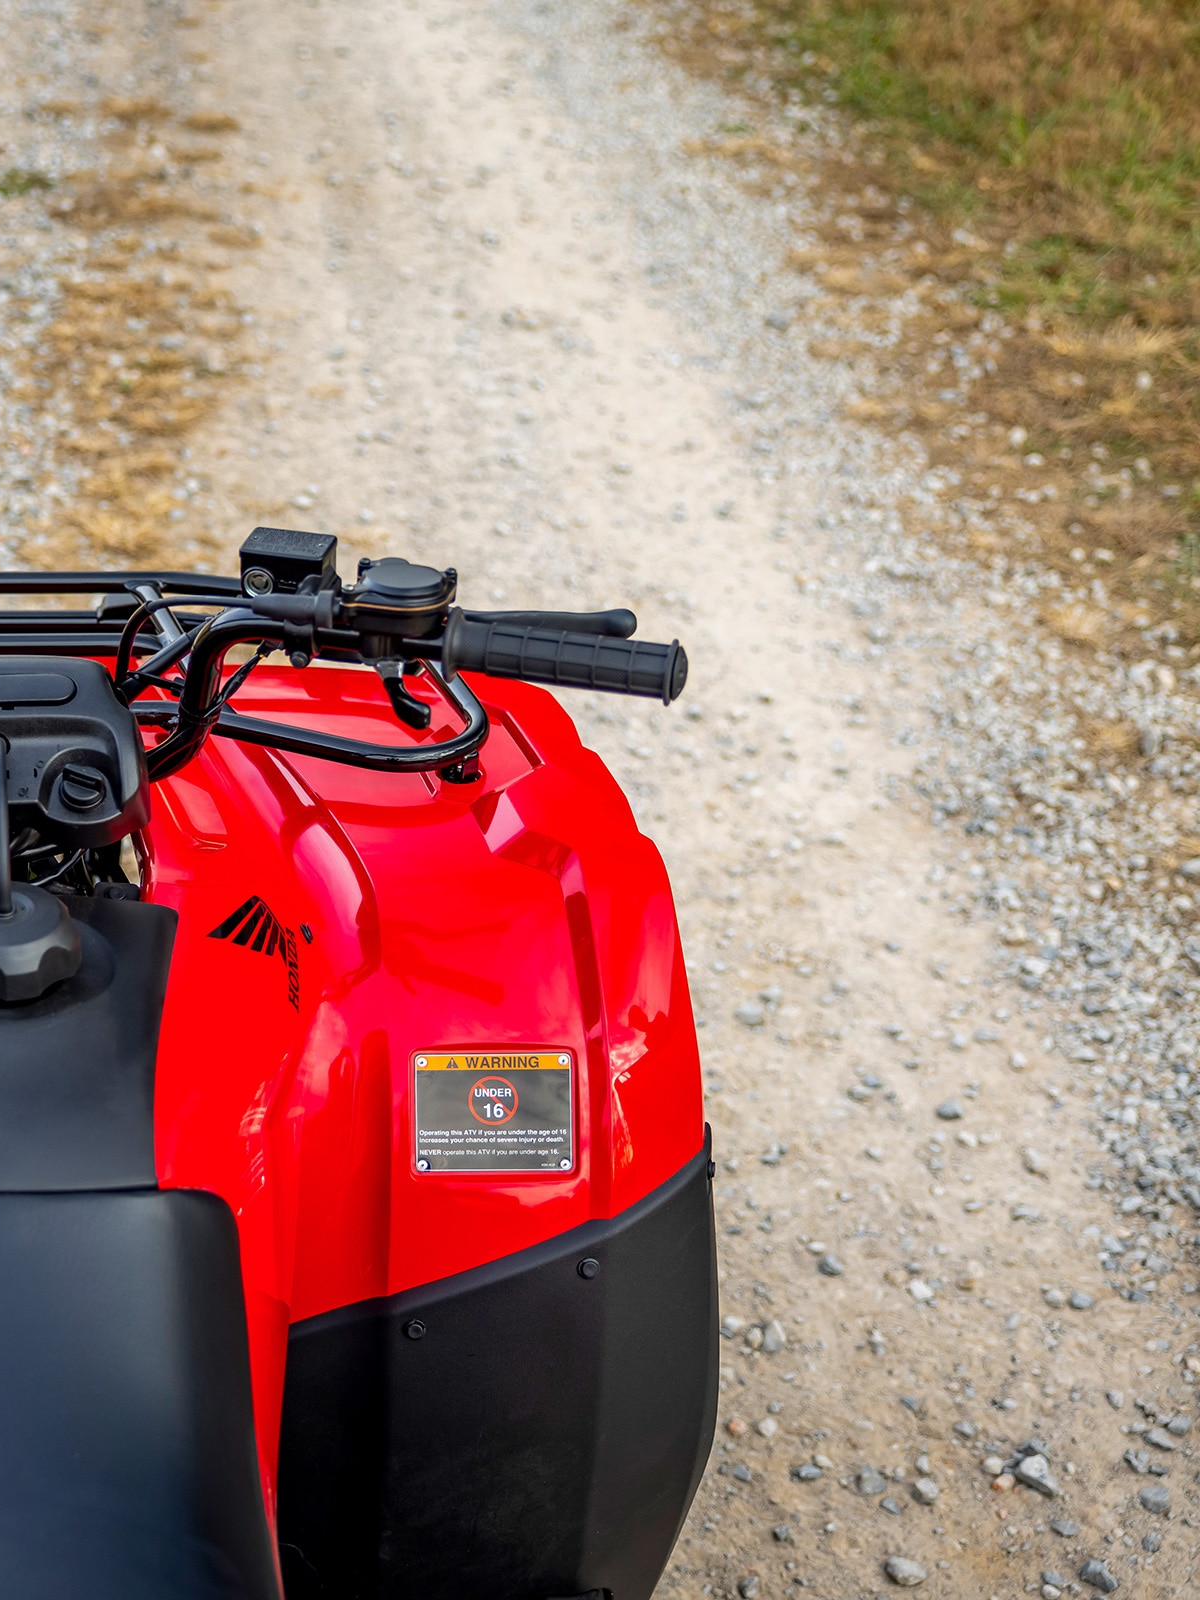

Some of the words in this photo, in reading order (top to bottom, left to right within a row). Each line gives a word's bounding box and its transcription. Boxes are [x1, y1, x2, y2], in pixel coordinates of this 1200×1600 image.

[285, 927, 300, 1014] HONDA
[466, 1056, 540, 1068] WARNING
[474, 1089, 512, 1097] UNDER
[484, 1103, 504, 1118] 16
